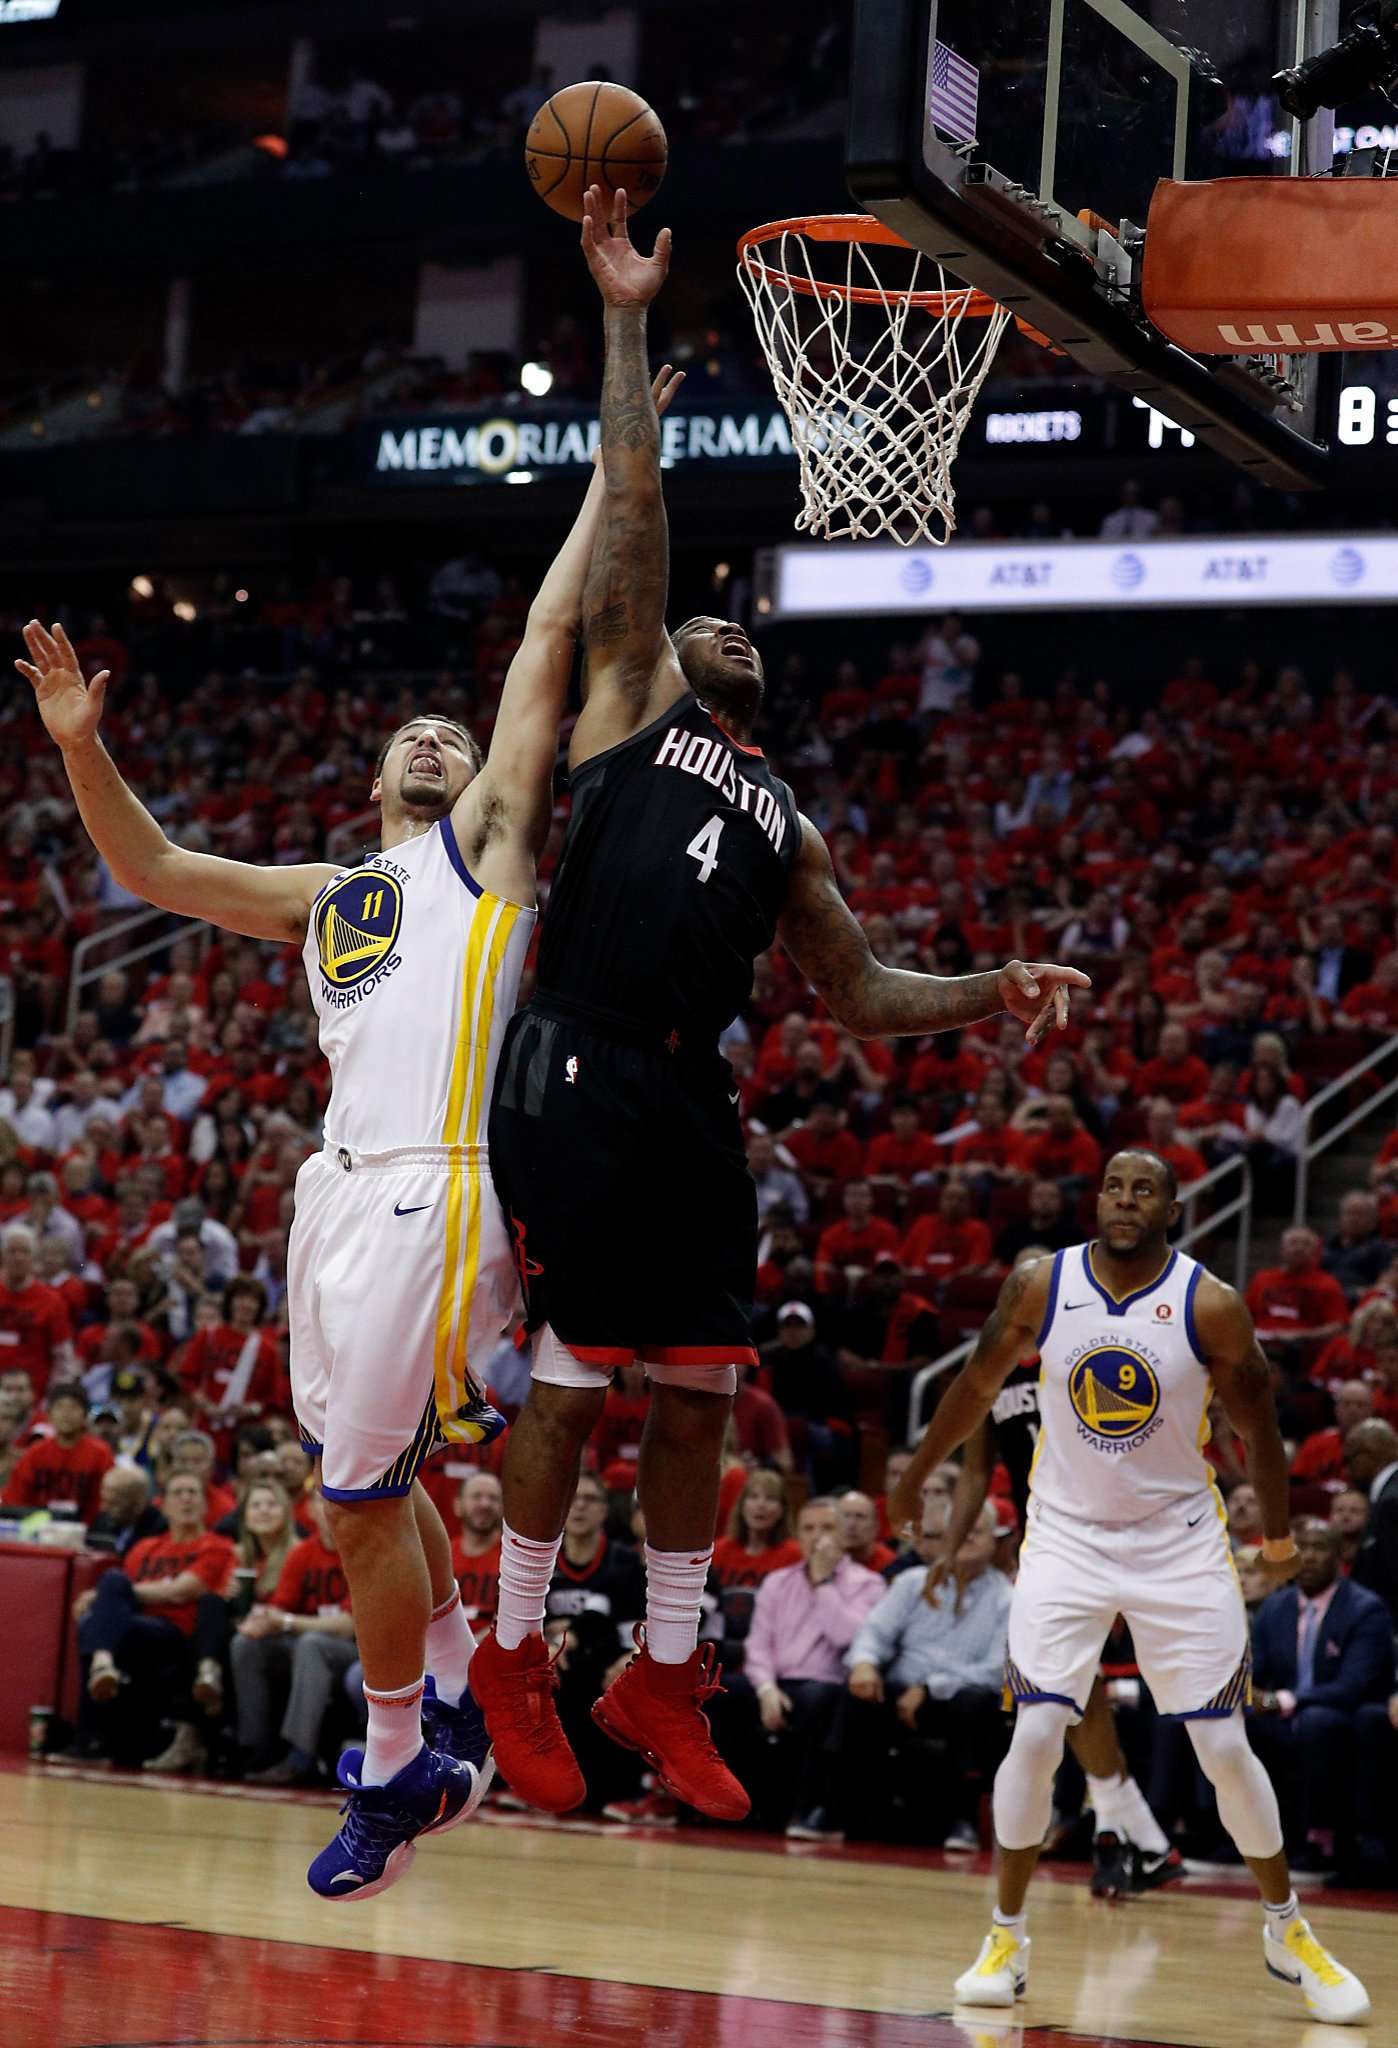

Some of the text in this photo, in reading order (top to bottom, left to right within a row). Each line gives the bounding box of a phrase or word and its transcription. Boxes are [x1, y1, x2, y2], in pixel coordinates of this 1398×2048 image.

[1217, 321, 1398, 347] arm
[989, 561, 1055, 588] AT&T
[1204, 557, 1269, 583] AT&T
[654, 727, 787, 855] HOUSTON
[685, 814, 726, 884] 4
[372, 858, 412, 886] STATE
[361, 889, 385, 921] 11
[321, 951, 402, 1009] WARRIORS
[1064, 1334, 1163, 1368] GOLDEN STATE
[1118, 1364, 1137, 1391] 9
[1076, 1416, 1165, 1455] WARRIORS
